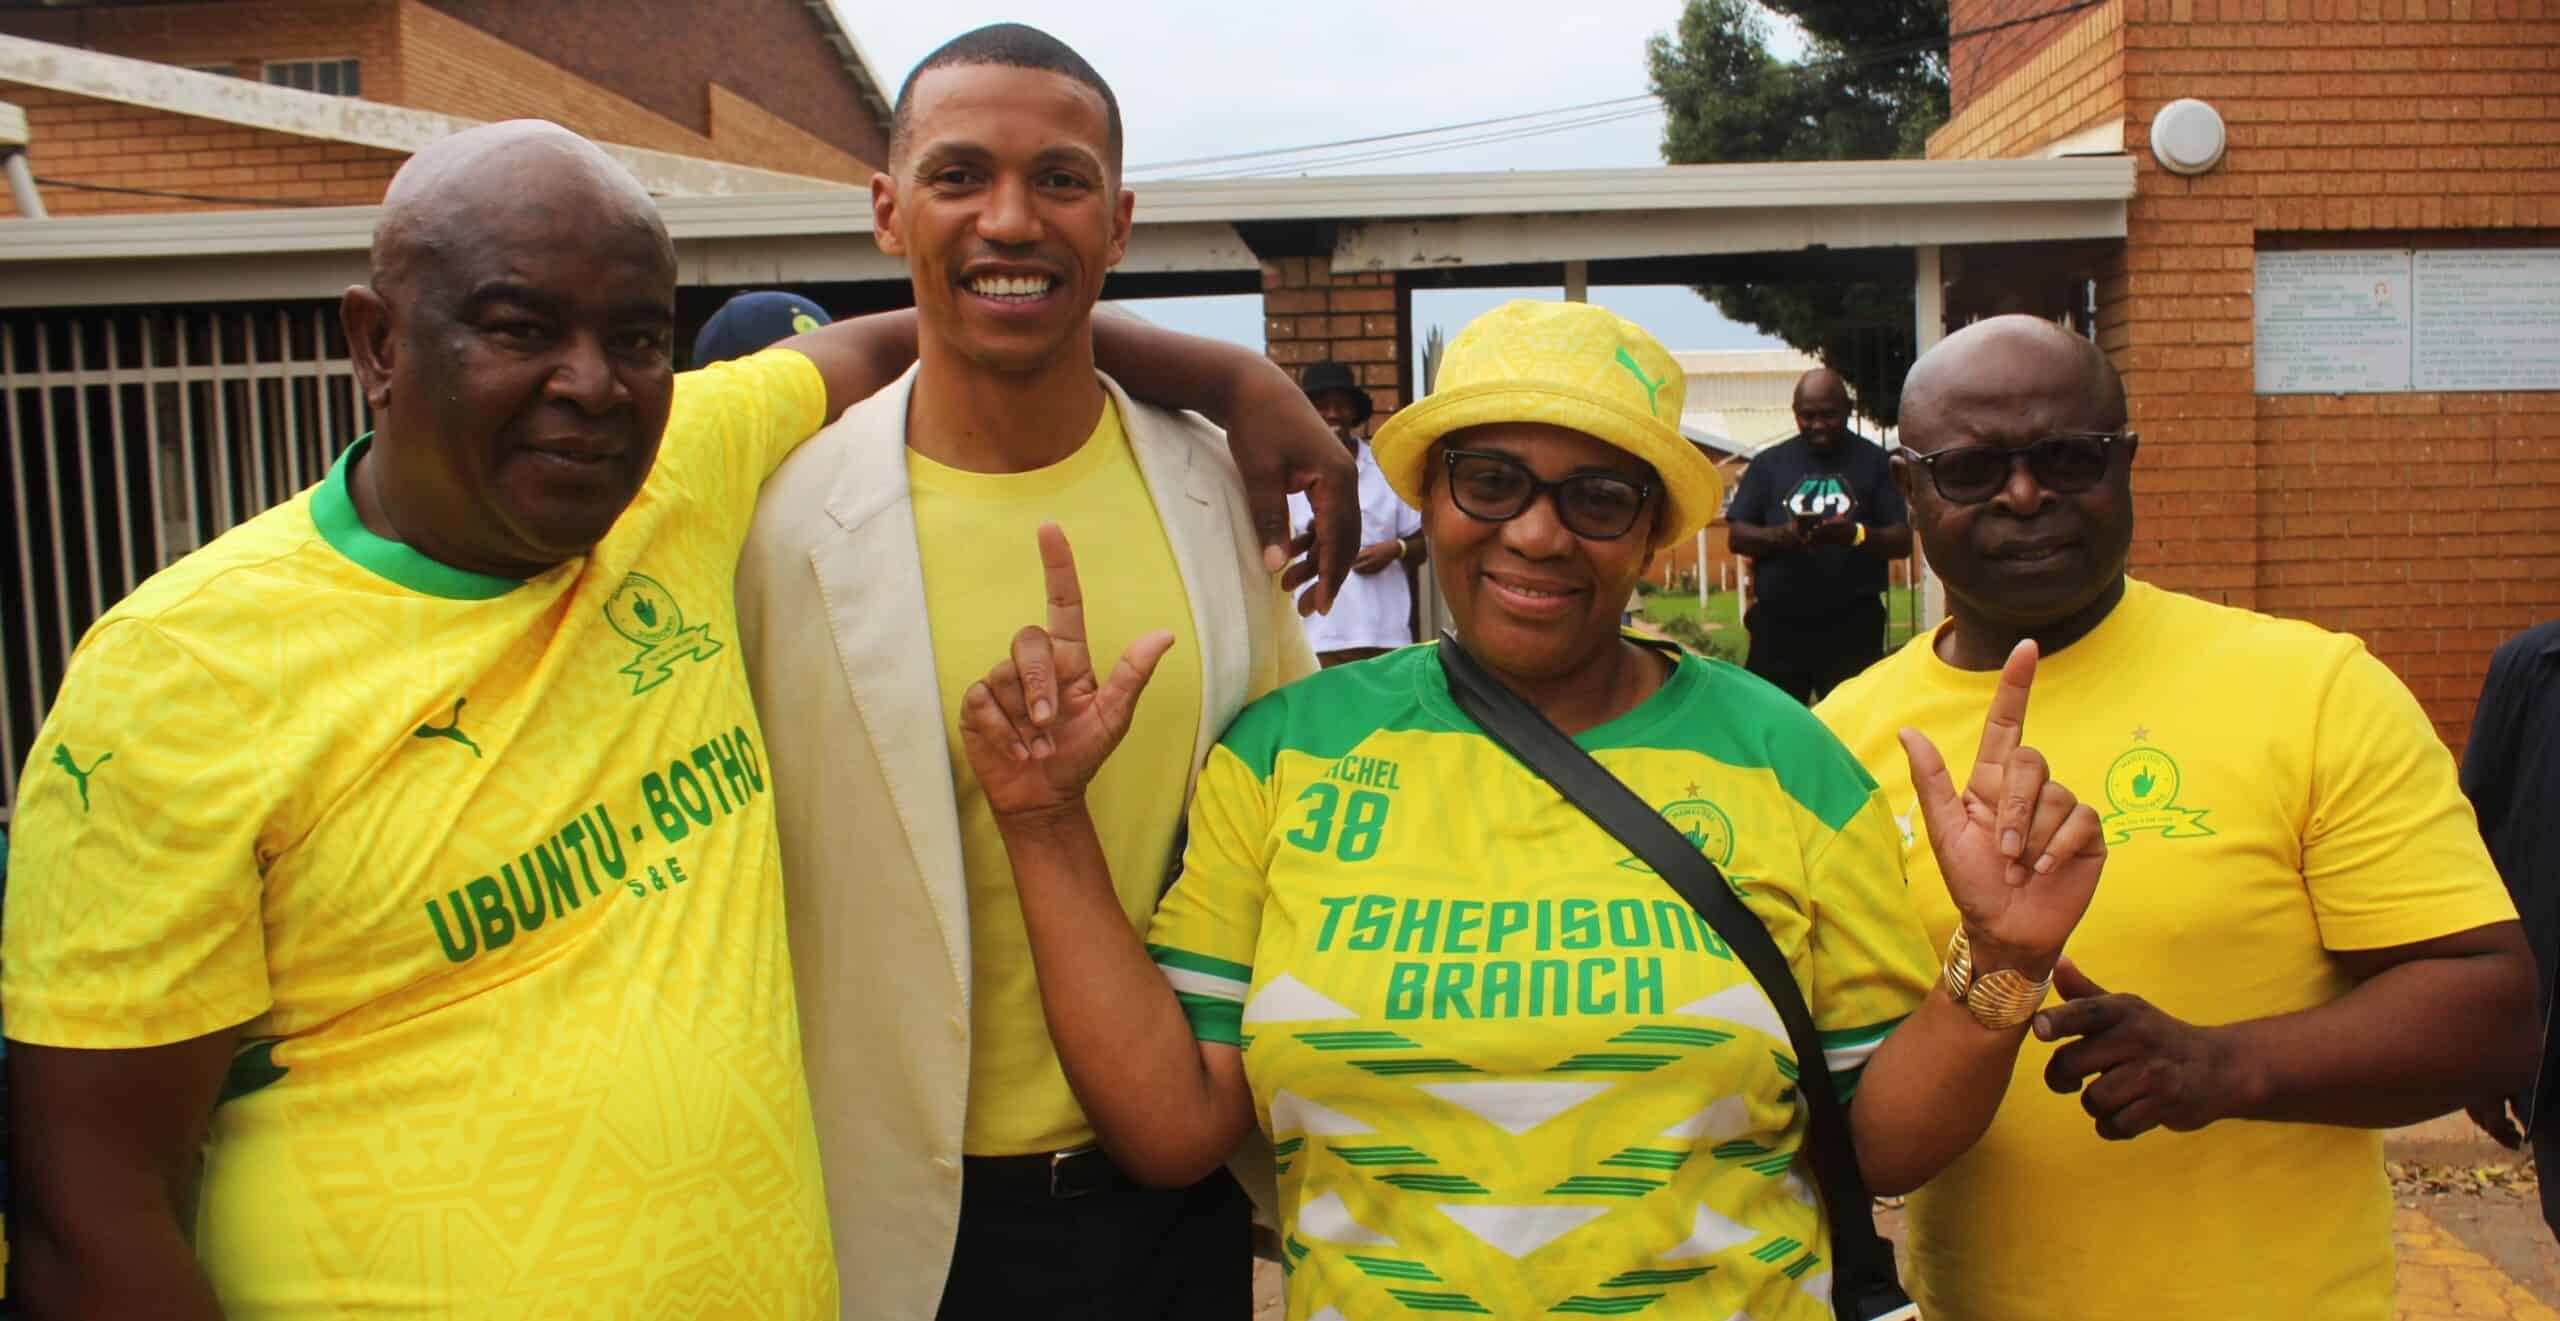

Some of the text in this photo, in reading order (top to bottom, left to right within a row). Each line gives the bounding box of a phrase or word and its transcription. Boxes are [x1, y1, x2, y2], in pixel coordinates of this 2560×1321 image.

[424, 803, 627, 963] UBUNTU
[641, 725, 765, 844] BOTHO
[1286, 782, 1391, 862] 38
[646, 865, 667, 892] &
[665, 856, 688, 883] E
[1384, 956, 1665, 1020] BRANCH
